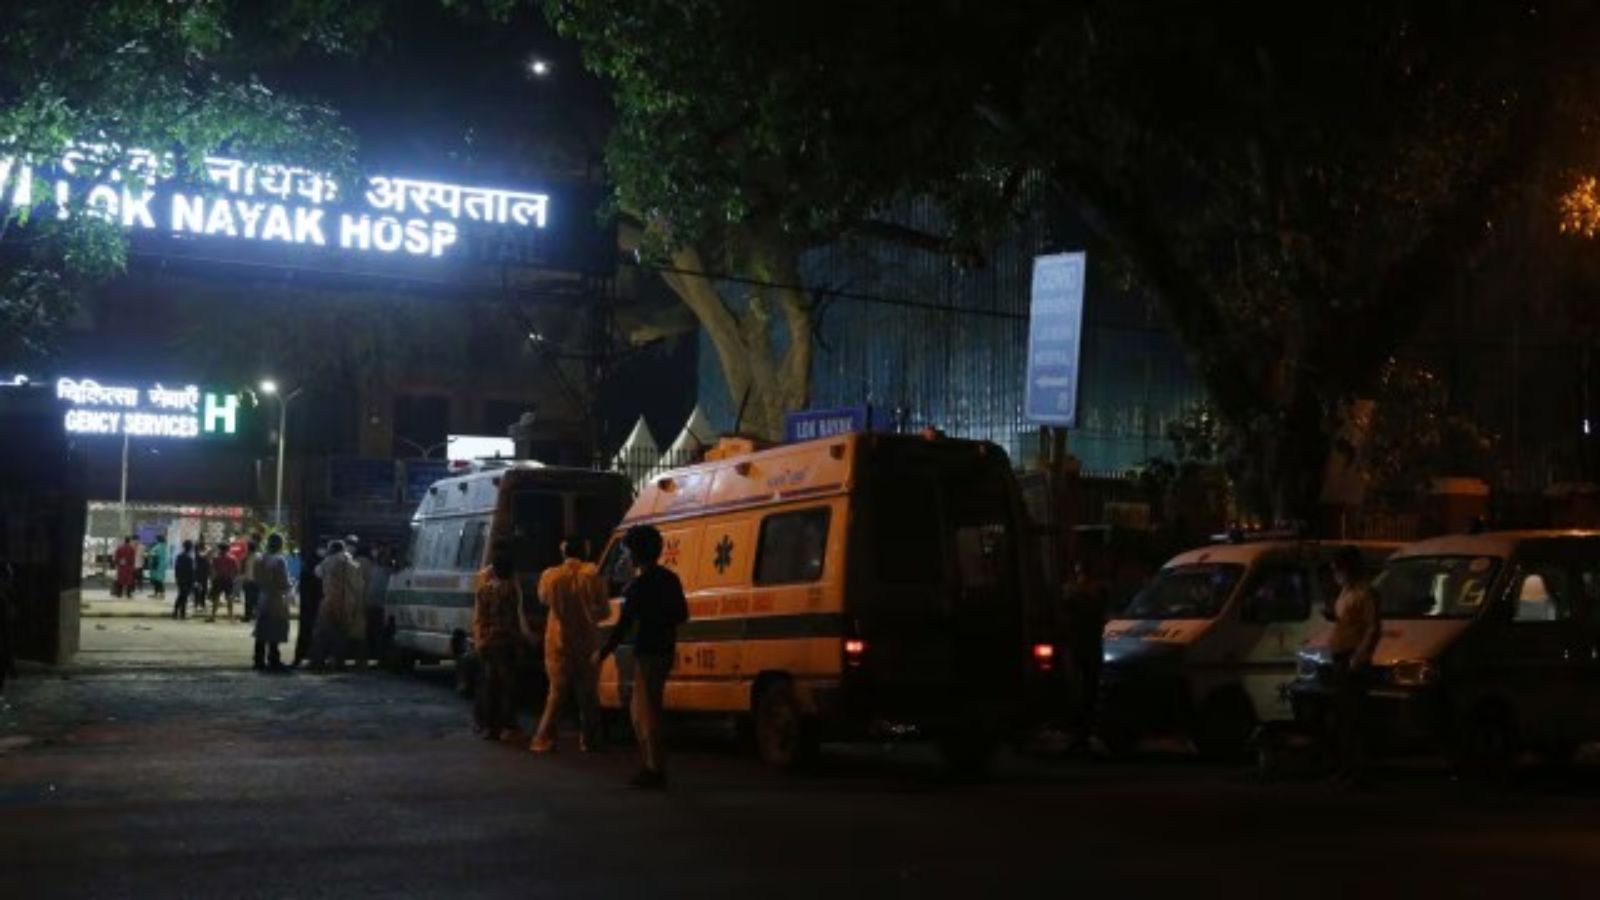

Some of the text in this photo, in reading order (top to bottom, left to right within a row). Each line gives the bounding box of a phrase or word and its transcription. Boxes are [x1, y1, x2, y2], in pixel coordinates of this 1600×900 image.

[172, 193, 326, 246] NAYAK
[366, 176, 548, 228] अस्पताल
[64, 409, 199, 437] GENCY SERVICES
[204, 393, 237, 433] H
